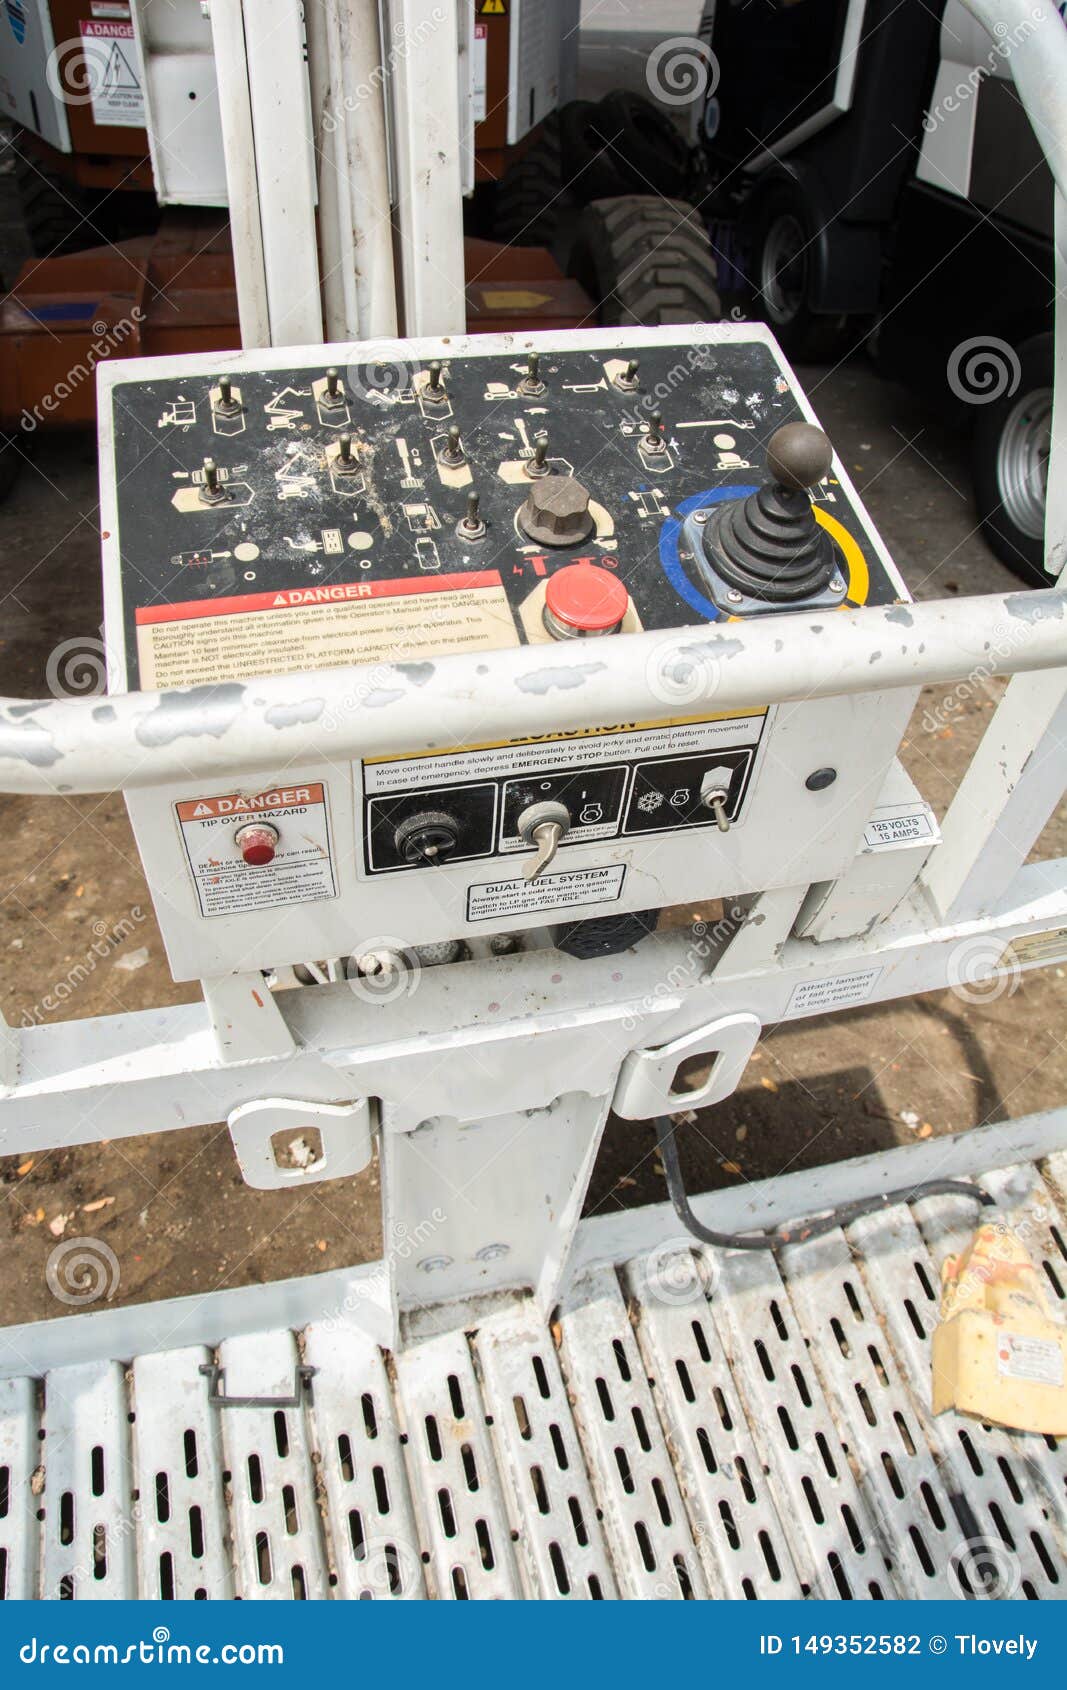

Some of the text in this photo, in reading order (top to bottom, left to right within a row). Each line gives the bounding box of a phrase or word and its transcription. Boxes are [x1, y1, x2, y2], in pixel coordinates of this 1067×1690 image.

[288, 585, 372, 604] DANGER
[153, 631, 194, 642] thoroughly
[197, 625, 242, 637] understand
[257, 619, 300, 630] information
[303, 616, 324, 624] given
[393, 605, 421, 615] Manual
[423, 603, 438, 611] and
[452, 597, 488, 608] DANGER
[490, 595, 505, 603] and
[166, 624, 178, 632] not
[181, 620, 211, 630] operate
[214, 618, 228, 626] this
[230, 614, 264, 624] machine
[266, 612, 292, 621] unless
[333, 602, 366, 612] qualified
[419, 595, 438, 603] have
[440, 593, 457, 601] read
[153, 639, 194, 649] CAUTION
[196, 636, 217, 644] signs
[232, 632, 246, 640] this
[154, 650, 188, 659] Maintain
[222, 641, 258, 651] minimum
[260, 636, 300, 647] clearance
[302, 634, 319, 642] from
[322, 629, 357, 639] electrical
[360, 626, 383, 634] power
[465, 615, 482, 623] This
[154, 658, 190, 668] machine
[201, 654, 219, 662] NOT
[222, 648, 265, 659] electrically
[170, 668, 183, 676] not
[185, 664, 215, 674] exceed
[217, 662, 230, 670] the
[232, 653, 304, 668] UNRESTRICTED
[306, 647, 354, 659] PLATFORM
[156, 679, 168, 687] Do
[171, 677, 184, 686] not
[186, 673, 218, 684] operate
[220, 671, 234, 679] this
[237, 667, 271, 677] machine
[274, 666, 284, 674] on
[287, 664, 303, 672] soft
[304, 662, 312, 670] or
[315, 658, 349, 669] unstable
[376, 767, 400, 776] Move
[402, 762, 432, 773] control
[434, 757, 465, 768] handle
[467, 755, 494, 765] slowly
[496, 753, 513, 761] and
[515, 745, 564, 758] deliberately
[578, 740, 600, 749] avoid
[603, 739, 624, 748] jerky
[625, 736, 642, 745] and
[644, 732, 671, 742] erratic
[672, 728, 705, 739] platform
[707, 722, 749, 734] movement
[376, 779, 385, 787] In
[386, 776, 408, 785] case
[410, 774, 419, 782] of
[474, 760, 509, 772] depress
[511, 754, 574, 769] EMERGENCY
[576, 750, 602, 760] STOP
[604, 745, 632, 756] button.
[634, 745, 650, 753] Pull
[652, 742, 666, 751] out
[667, 741, 676, 749] to
[677, 738, 701, 747] reset.
[218, 789, 310, 812] DANGER
[200, 808, 307, 828] TIP OVER HAZARD
[872, 818, 919, 832] 125 VOLTS
[880, 828, 920, 840] 15 AMPS
[207, 864, 237, 872] machine
[486, 871, 608, 894] DUAL FUEL SYSTEM
[471, 894, 500, 904] Always
[501, 891, 519, 899] start
[528, 888, 545, 896] cold
[546, 884, 573, 893] engine
[471, 901, 497, 910] Switch
[537, 893, 555, 901] after
[471, 906, 496, 915] engine
[498, 902, 528, 911] running
[540, 897, 558, 905] FAST
[800, 972, 874, 992] Attach lanyard
[828, 982, 869, 994] restraint
